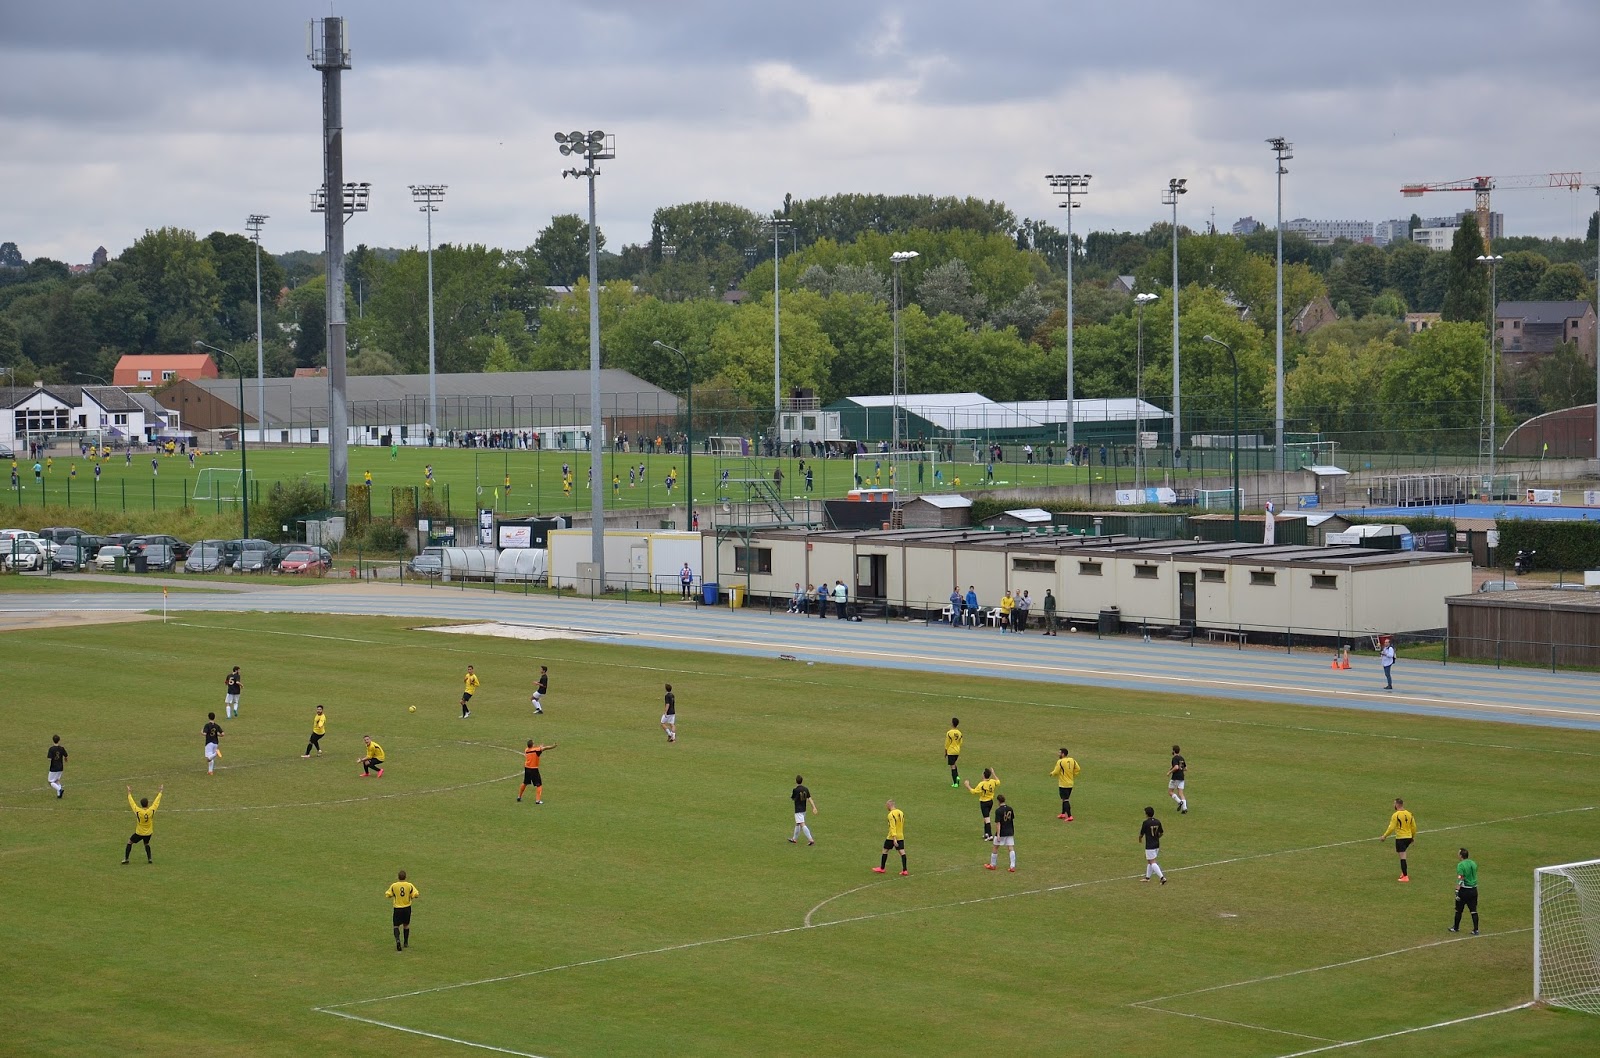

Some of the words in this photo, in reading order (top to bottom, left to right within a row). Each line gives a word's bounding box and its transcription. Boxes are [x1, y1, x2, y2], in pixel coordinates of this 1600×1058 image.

[143, 813, 149, 823] 9
[1150, 825, 1159, 837] 17
[399, 886, 406, 897] 8
